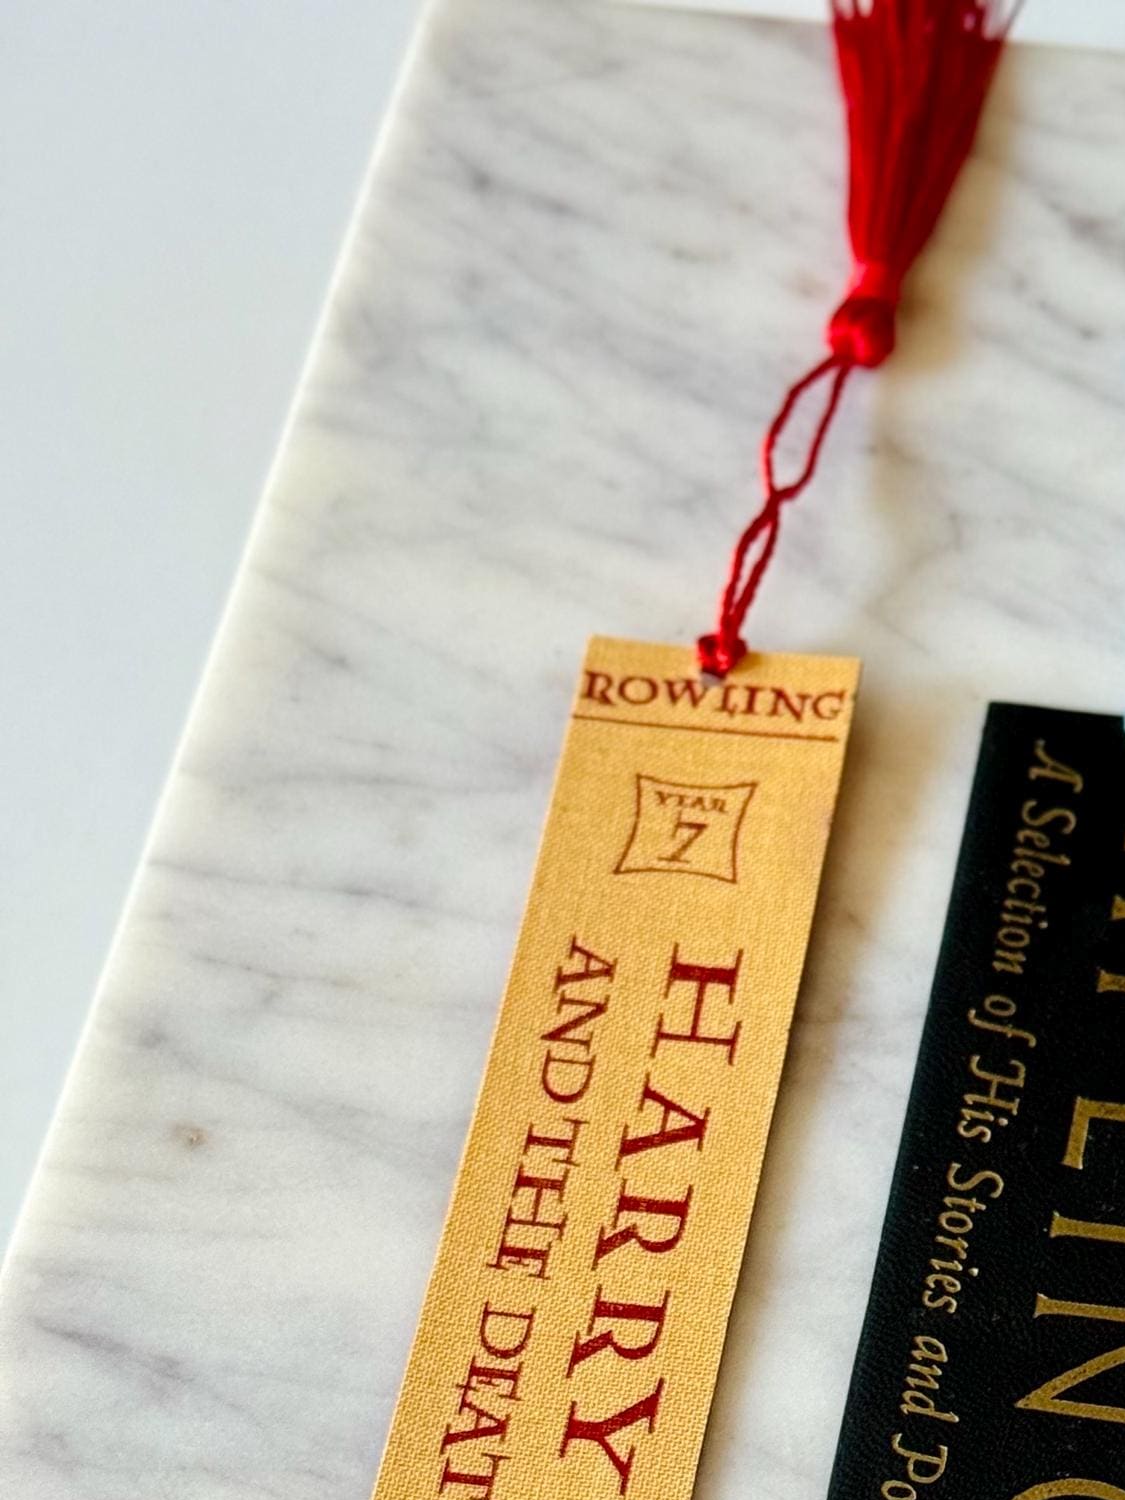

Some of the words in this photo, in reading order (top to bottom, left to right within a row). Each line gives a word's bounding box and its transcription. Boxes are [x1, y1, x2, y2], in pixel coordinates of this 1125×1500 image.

[580, 671, 847, 723] ROWLING
[655, 790, 729, 814] YEAR
[1028, 740, 1083, 793] A
[656, 810, 708, 864] 7
[992, 801, 1076, 974] Selection
[540, 935, 617, 1103] AND
[968, 994, 1036, 1047] of
[957, 1054, 1026, 1143] His
[486, 1118, 589, 1279] THE
[559, 943, 743, 1495] HARRY
[922, 1162, 1004, 1314] Stories
[900, 1335, 959, 1423] and
